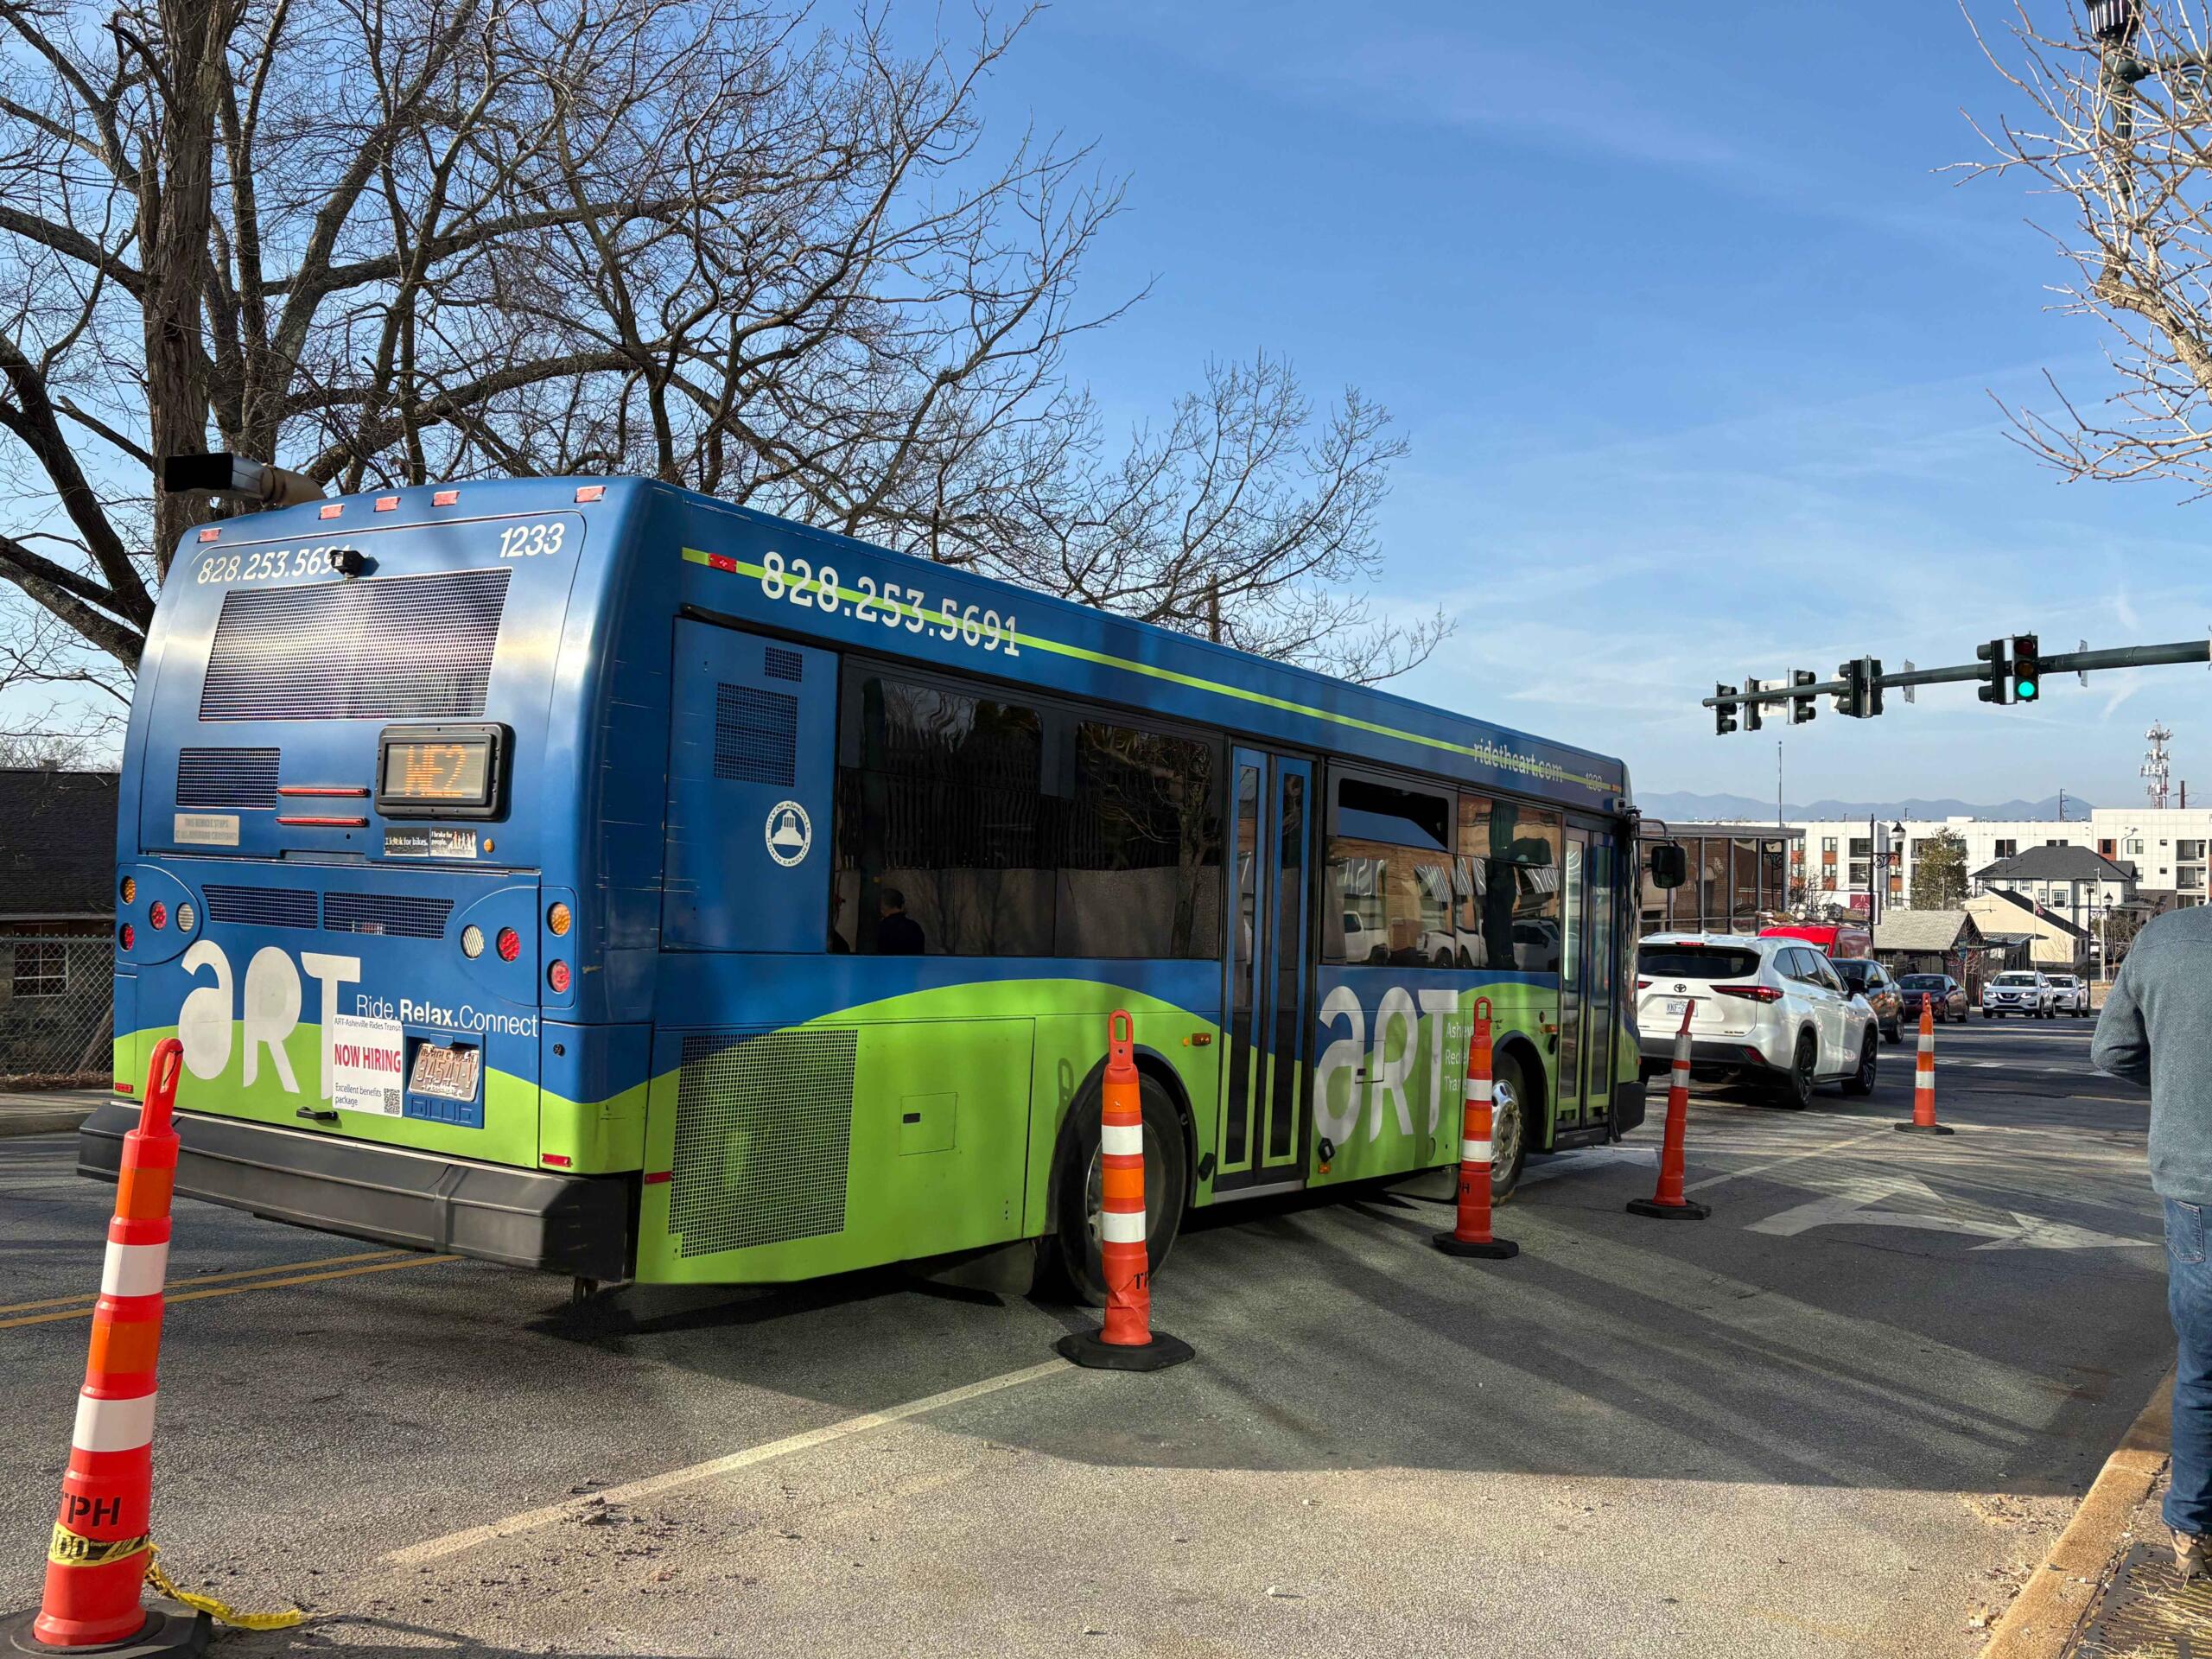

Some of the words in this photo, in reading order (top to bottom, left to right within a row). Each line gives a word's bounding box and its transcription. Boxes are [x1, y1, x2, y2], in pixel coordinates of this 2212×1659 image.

[499, 523, 565, 558] 1233
[197, 544, 351, 584] 828.253.569
[761, 551, 1020, 657] 828.253.5691
[1473, 739, 1563, 784] ridetheart.com
[1446, 1022, 1474, 1038] Ashev
[334, 1043, 360, 1068] NOW
[363, 1046, 401, 1073] HIRING
[334, 1096, 359, 1108] package
[335, 1082, 359, 1095] Excellent
[359, 1085, 382, 1097] benefits
[65, 1493, 121, 1527] PH
